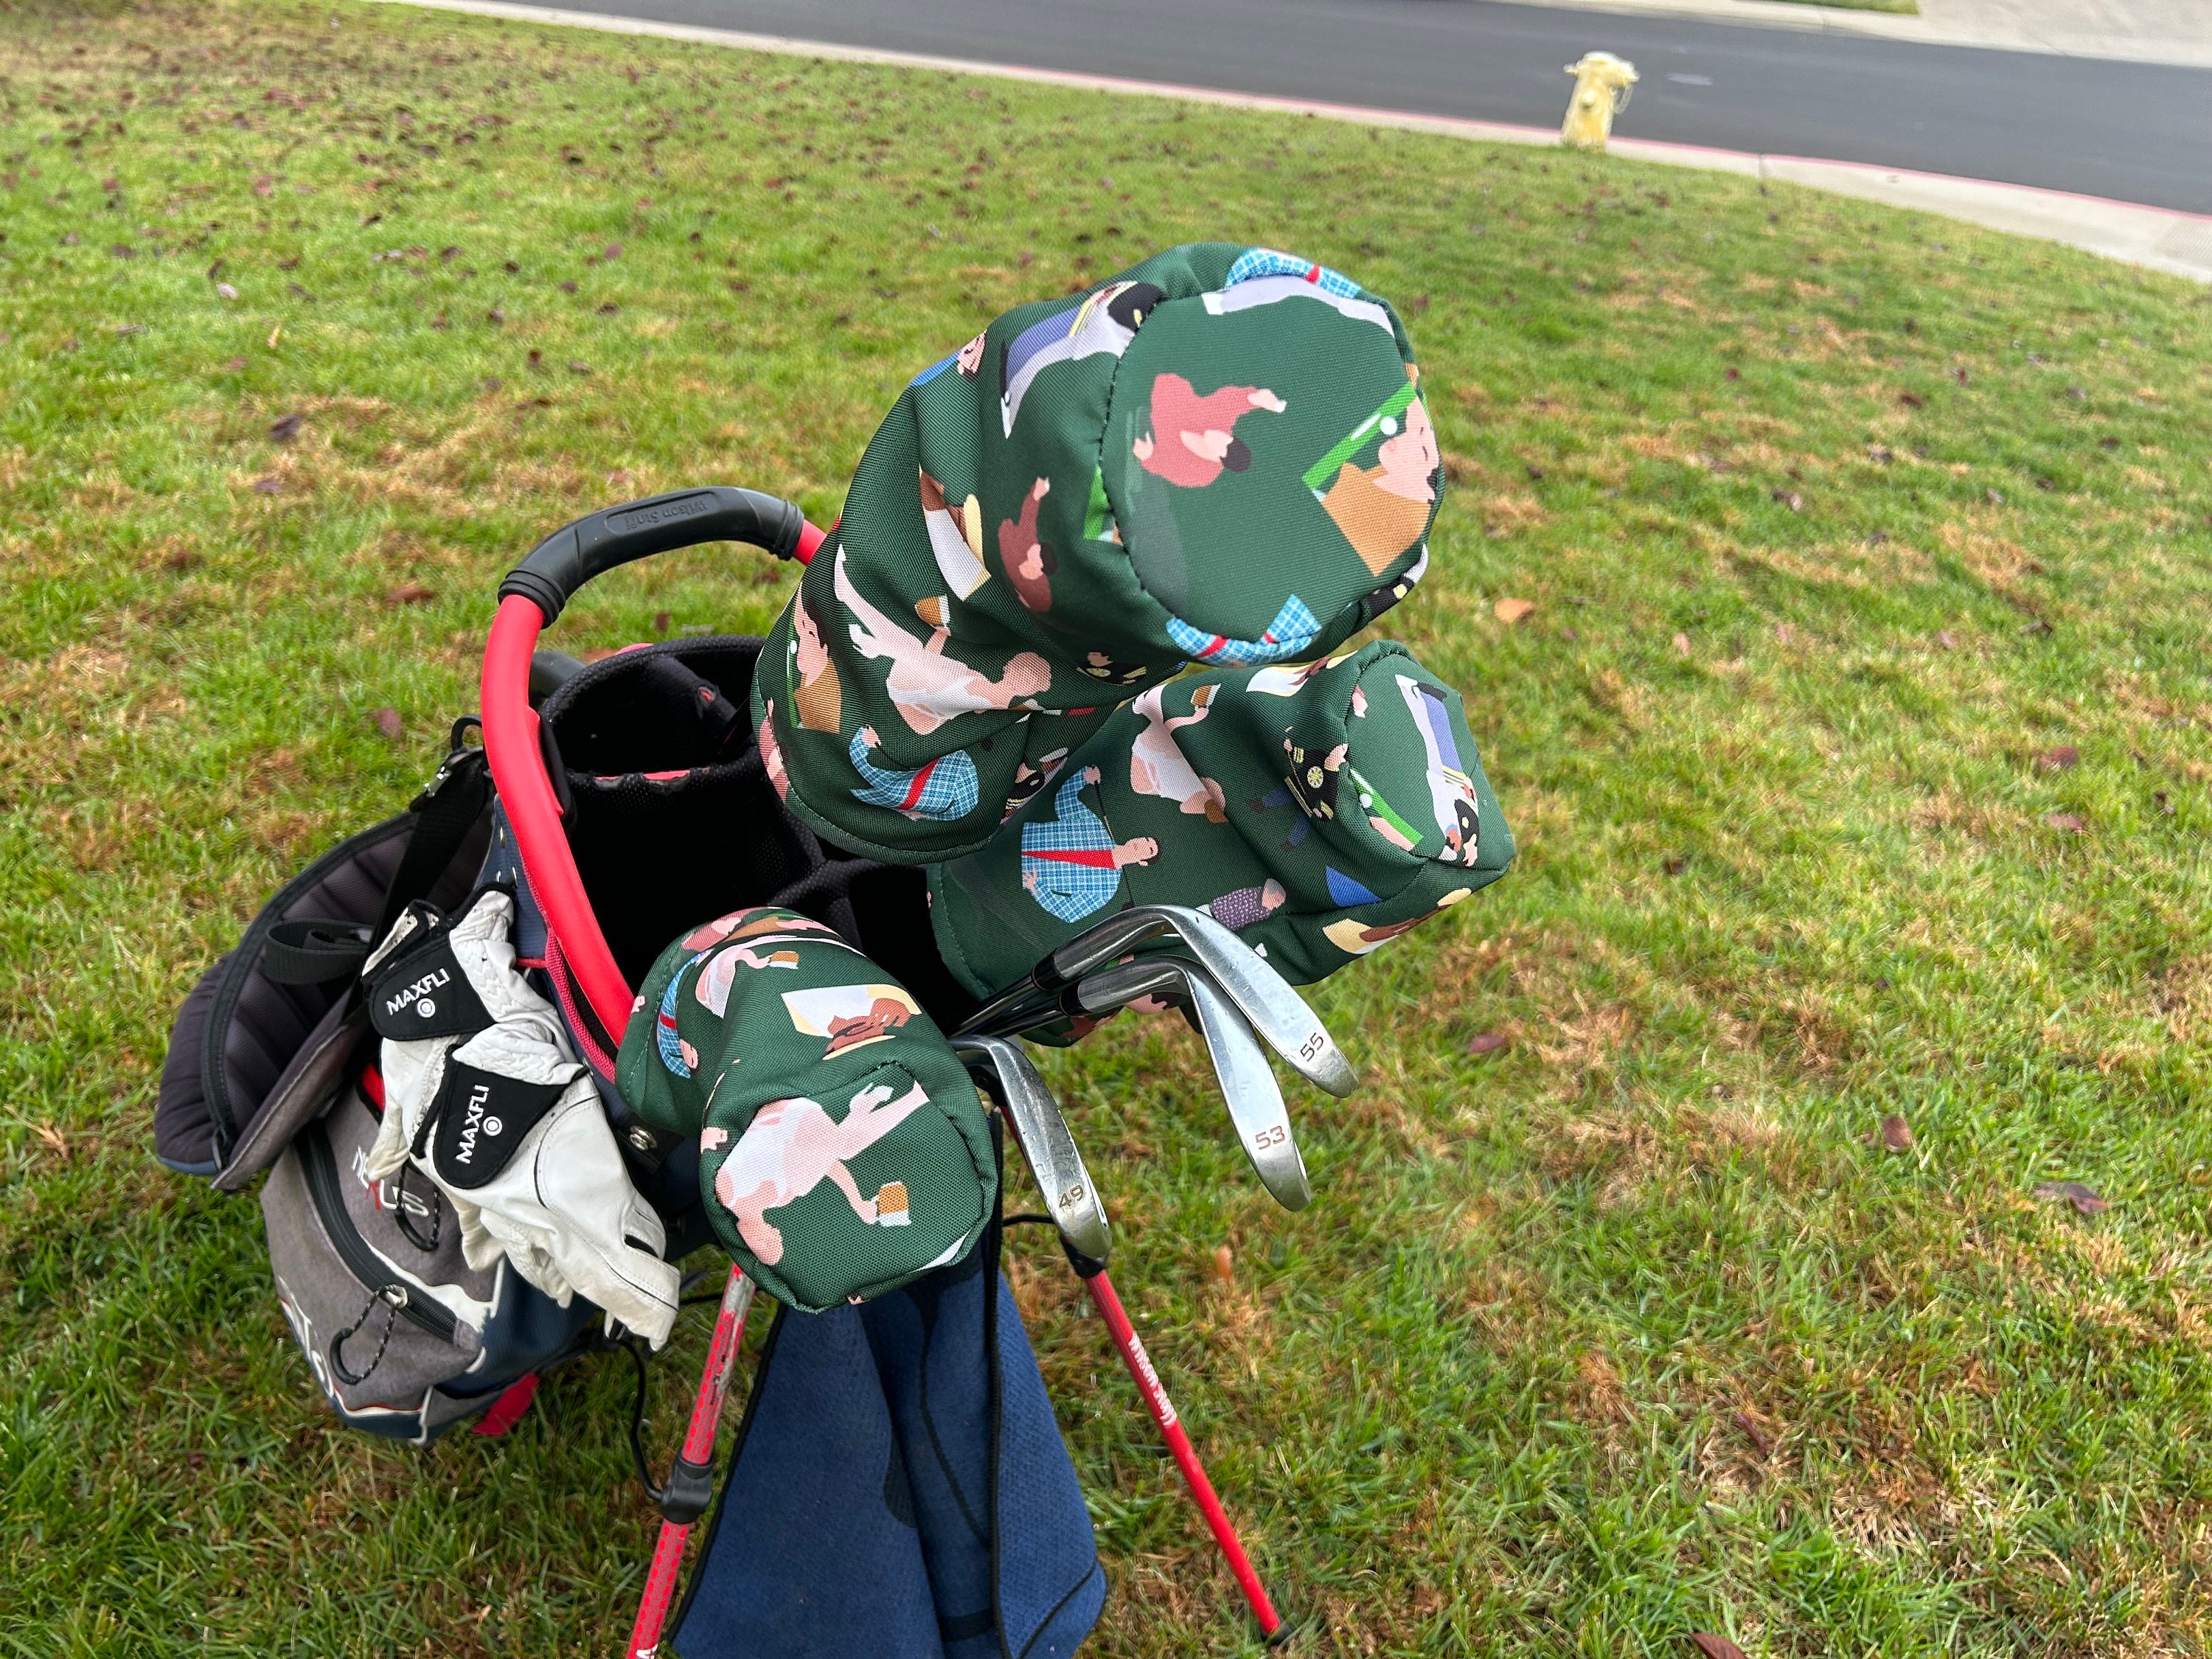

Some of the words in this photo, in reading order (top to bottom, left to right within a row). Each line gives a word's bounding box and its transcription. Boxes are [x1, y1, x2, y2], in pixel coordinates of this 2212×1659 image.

[386, 967, 451, 1015] MAXFLI
[1300, 1032, 1324, 1062] 55
[456, 1085, 489, 1164] MAXFLI
[1255, 1125, 1285, 1150] 53
[1059, 1184, 1084, 1208] 49
